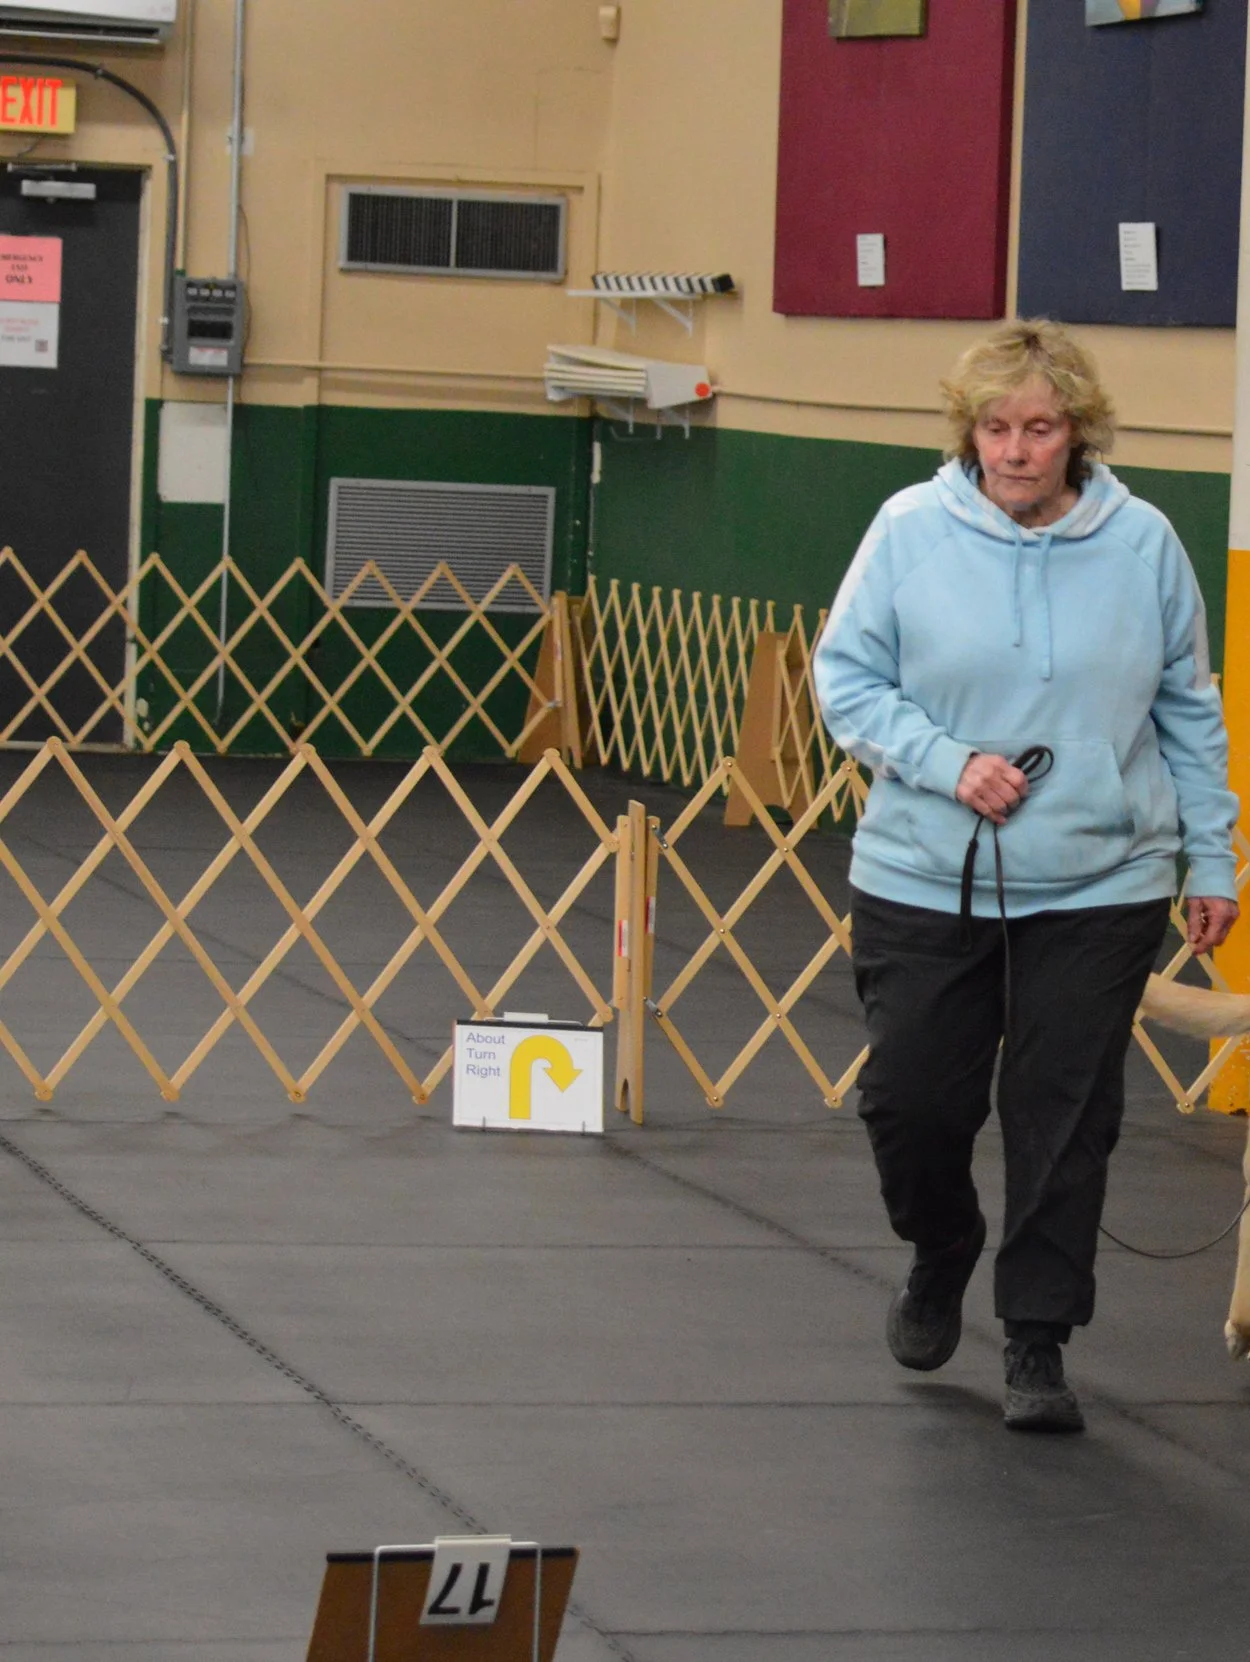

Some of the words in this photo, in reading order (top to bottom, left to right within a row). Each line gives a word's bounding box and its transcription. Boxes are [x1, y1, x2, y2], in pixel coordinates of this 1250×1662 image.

[1, 75, 63, 127] EXIT
[466, 1032, 505, 1045] About
[466, 1047, 496, 1060] Turn
[466, 1063, 501, 1078] Right
[427, 1562, 495, 1615] 17
